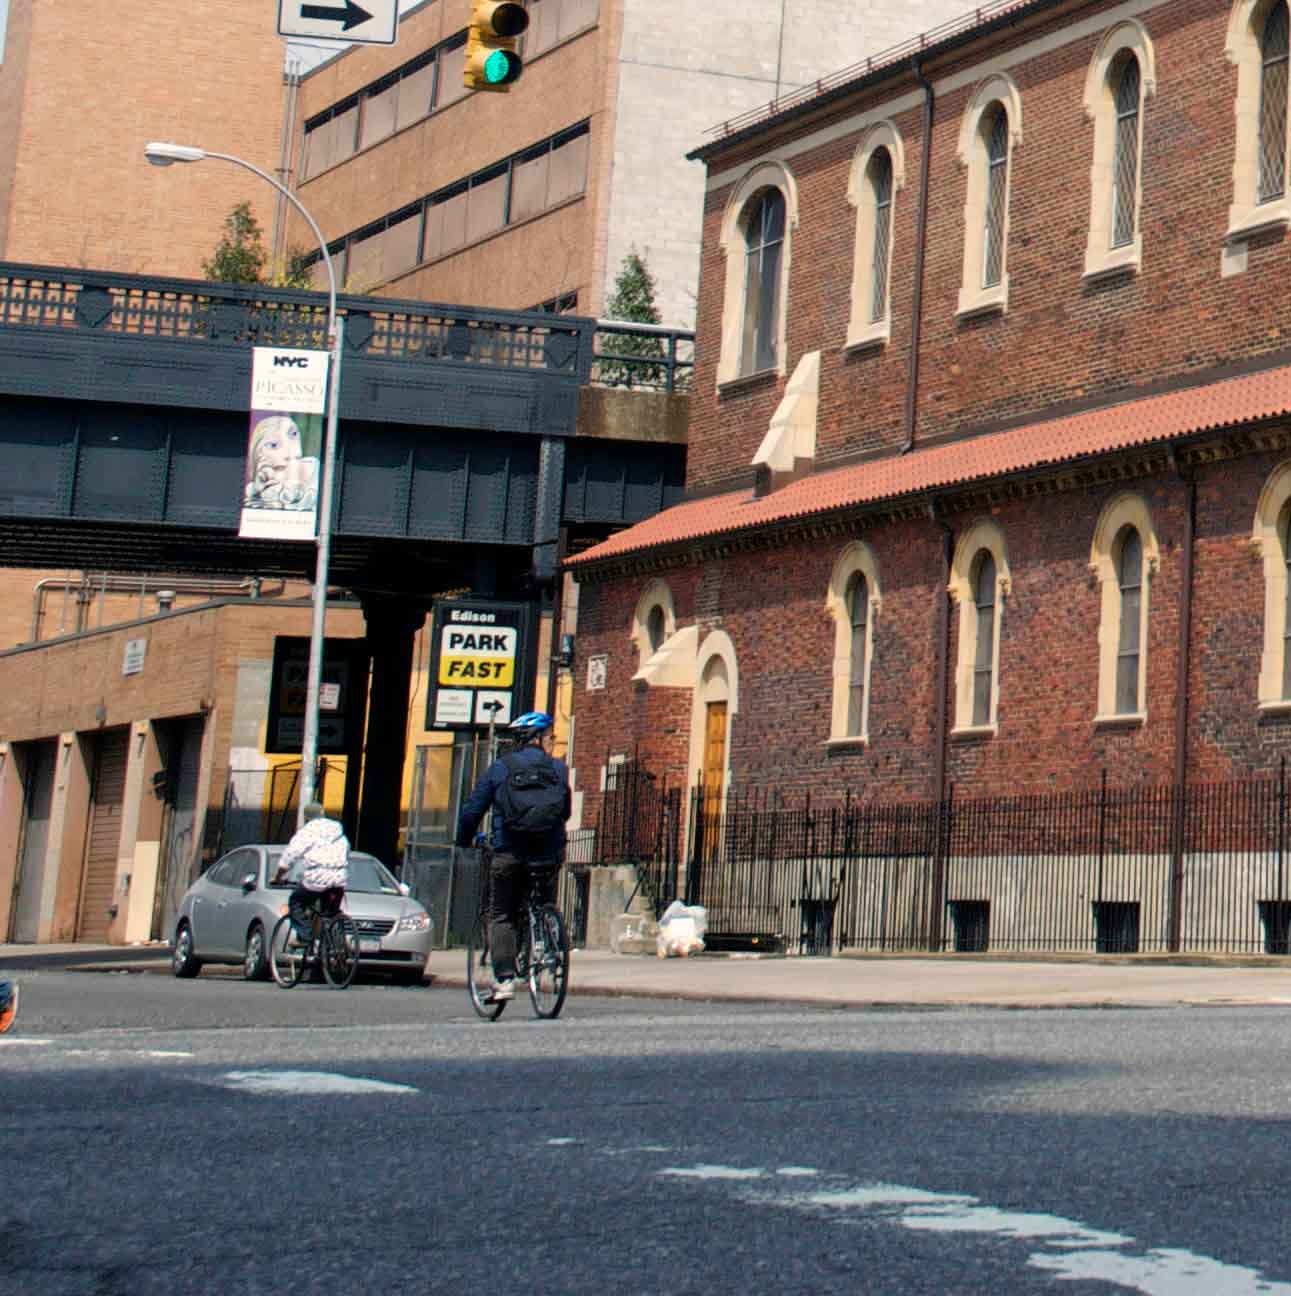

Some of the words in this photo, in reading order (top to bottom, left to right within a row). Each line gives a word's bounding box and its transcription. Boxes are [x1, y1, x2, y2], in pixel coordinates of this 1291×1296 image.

[272, 355, 309, 369] NYC
[450, 609, 497, 623] Edison
[449, 632, 509, 652] PARK
[447, 660, 507, 679] FAST
